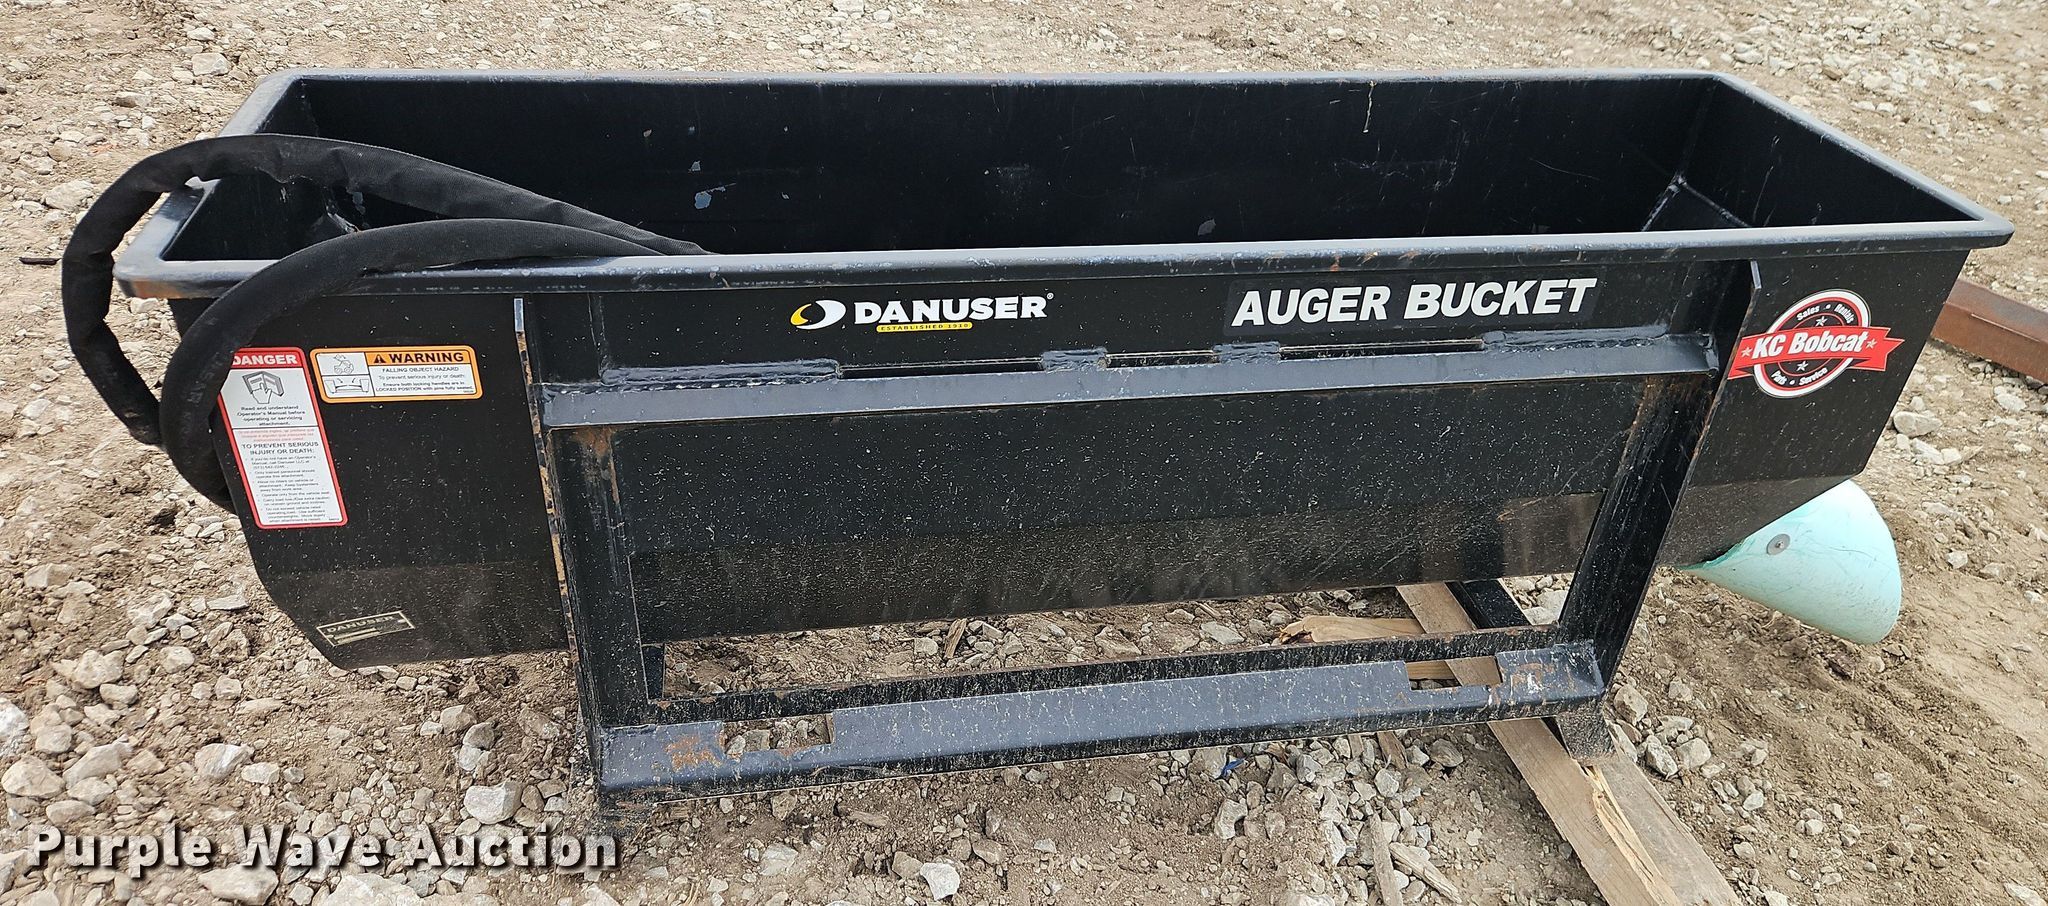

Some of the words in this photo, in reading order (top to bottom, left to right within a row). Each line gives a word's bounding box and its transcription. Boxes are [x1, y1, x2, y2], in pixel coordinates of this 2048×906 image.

[854, 296, 1047, 324] DANUSER
[1231, 286, 1391, 327] AUGER
[1403, 277, 1598, 320] BUCKET
[1796, 304, 1820, 321] Sales
[1834, 303, 1855, 324] Rentals
[1751, 334, 1786, 359] KC
[1787, 330, 1869, 355] Bobcat
[232, 354, 299, 366] DANGER
[389, 352, 465, 363] WARNING
[1798, 367, 1828, 386] Service
[326, 616, 393, 633] DANUSER
